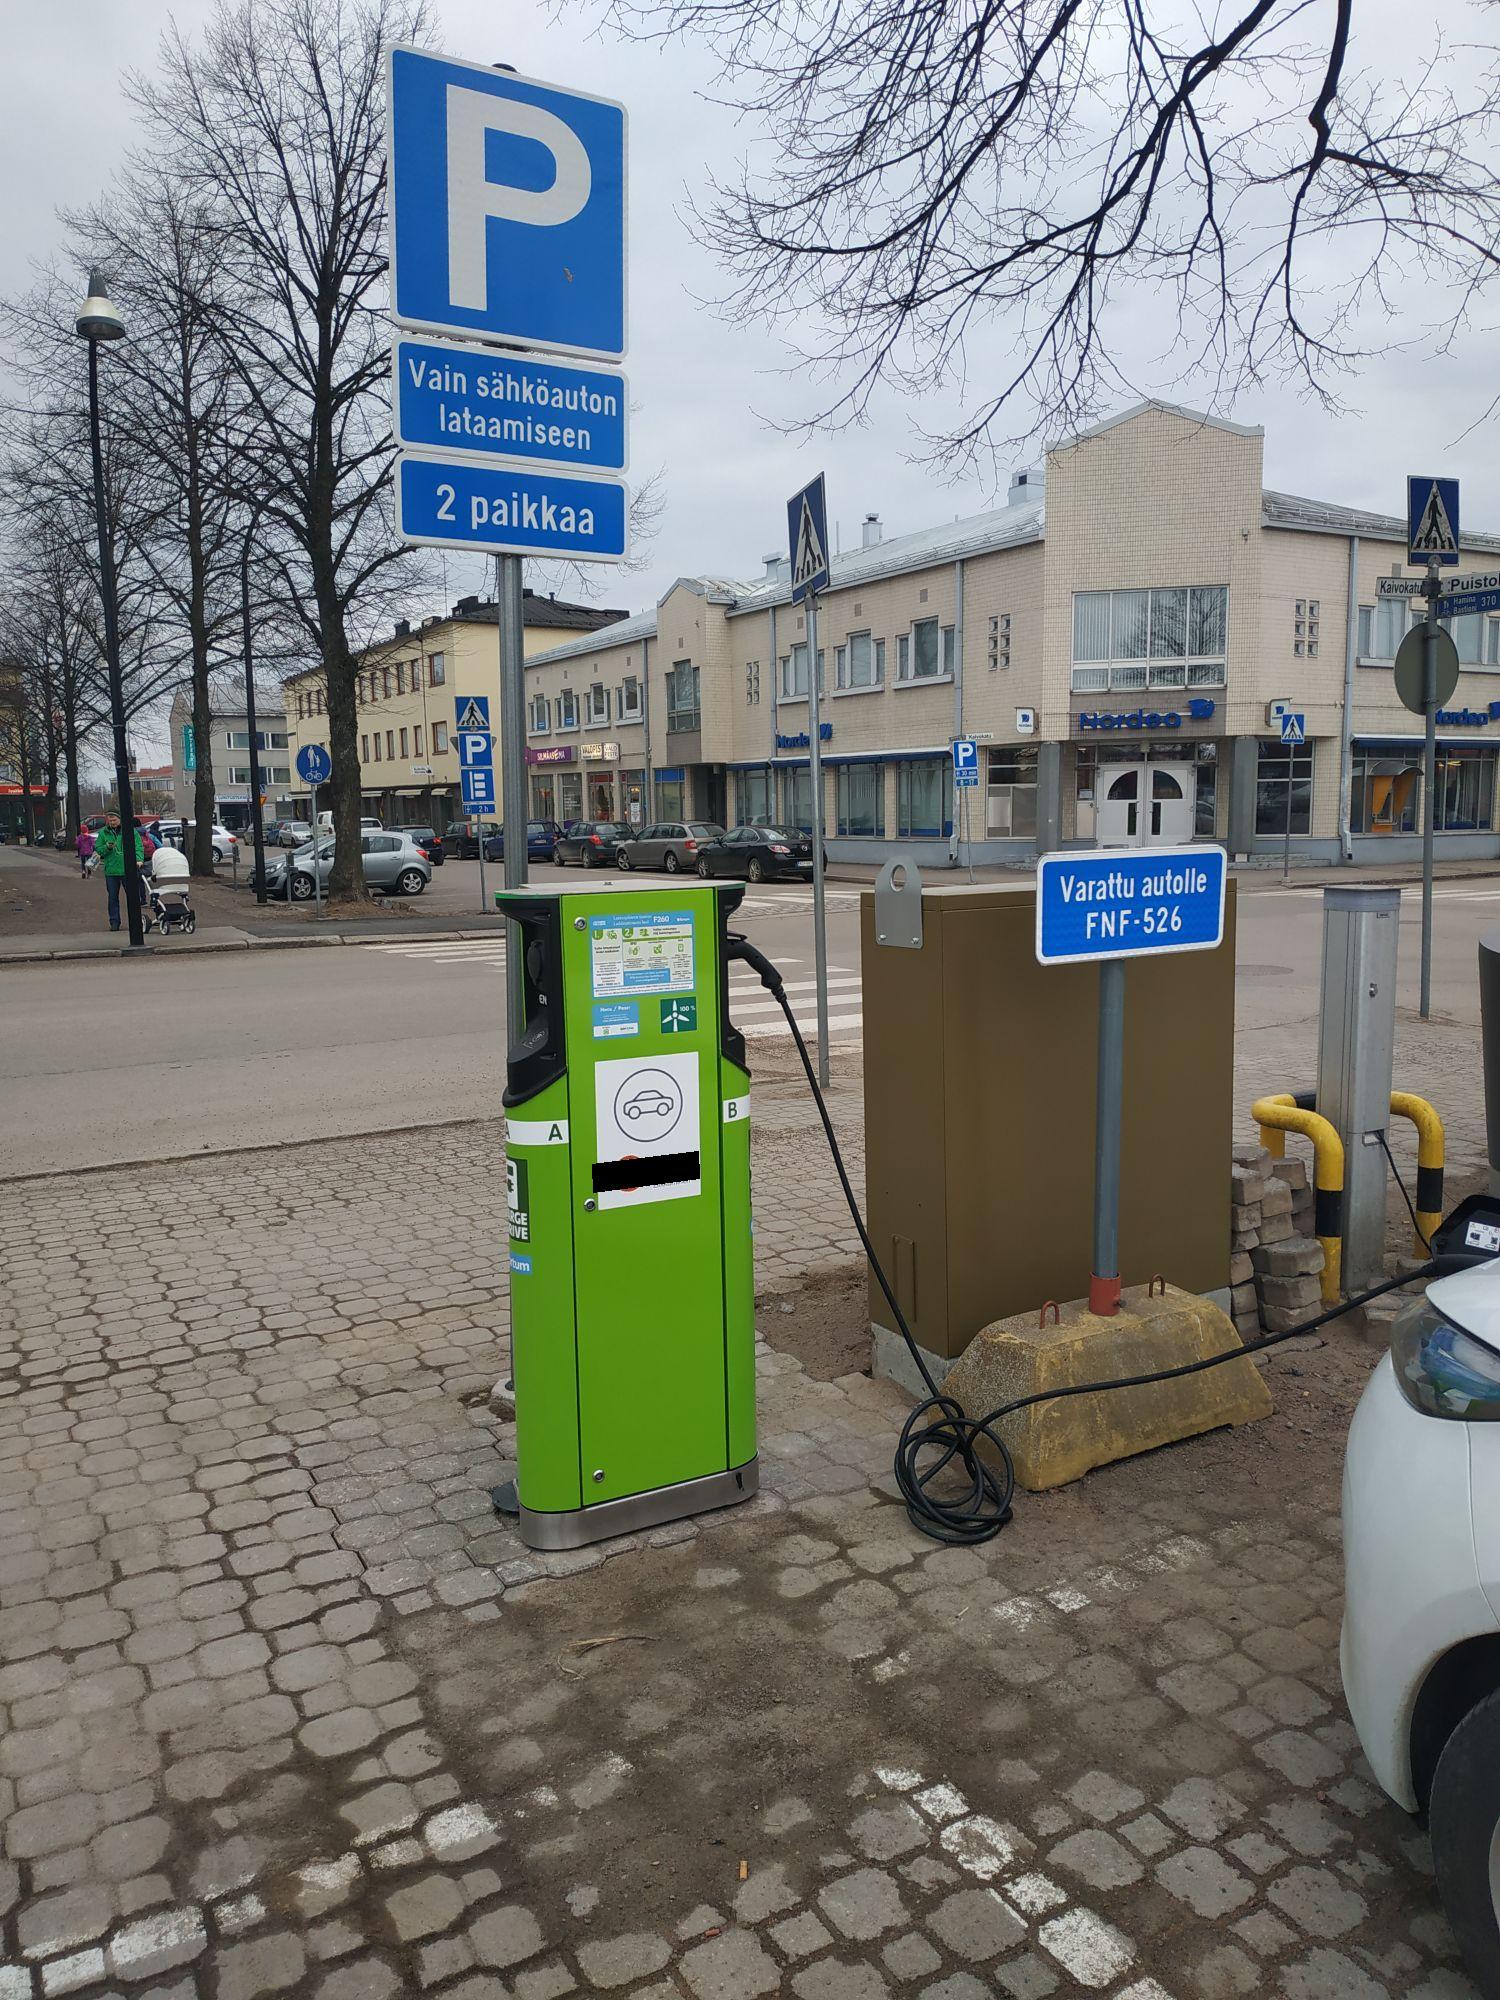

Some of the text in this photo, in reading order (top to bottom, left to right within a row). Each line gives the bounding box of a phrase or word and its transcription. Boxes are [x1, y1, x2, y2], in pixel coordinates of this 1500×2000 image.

[446, 83, 592, 312] P
[408, 358, 617, 417] Vain sähköauton
[439, 403, 591, 451] lataamiseen
[436, 483, 595, 535] 2 paikkaa
[1380, 580, 1421, 594] Kaivokatu
[1450, 573, 1500, 591] Puisto
[1079, 708, 1182, 731] Nordea
[465, 735, 487, 765] P
[777, 732, 811, 749] Norde
[957, 743, 974, 767] P
[478, 805, 483, 813] 2
[1059, 868, 1208, 903] Varattu autolle
[653, 915, 670, 924] F260
[1086, 905, 1183, 940] FNF-526
[728, 1102, 738, 1118] B
[548, 1123, 563, 1141] A
[509, 1209, 528, 1225] RGE
